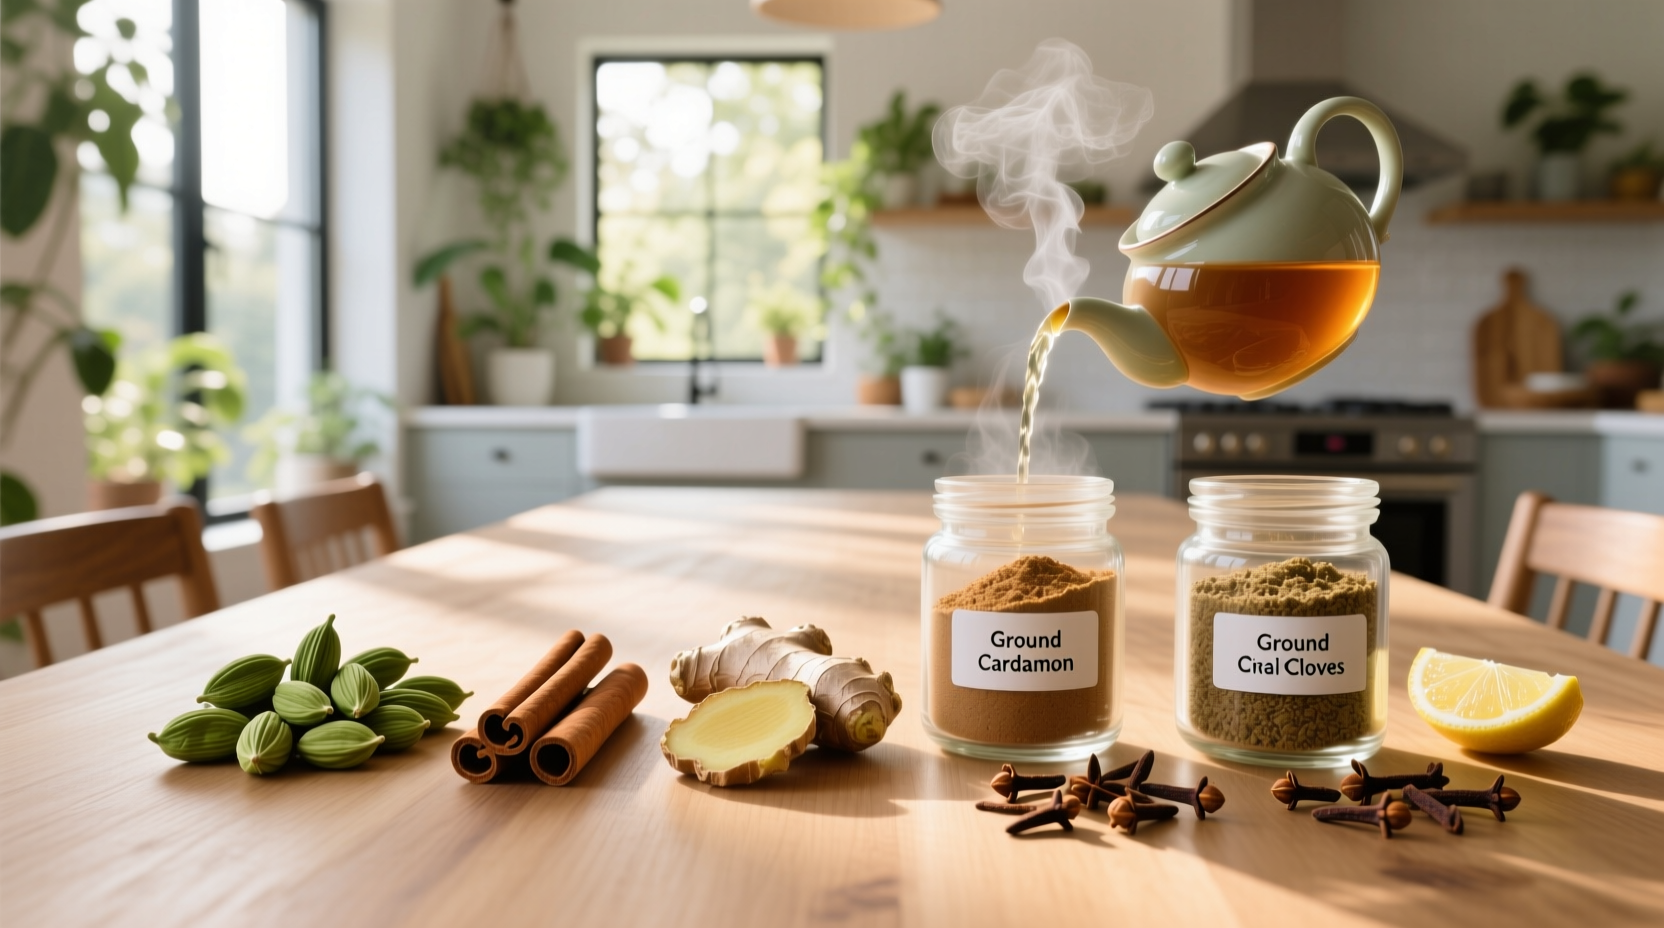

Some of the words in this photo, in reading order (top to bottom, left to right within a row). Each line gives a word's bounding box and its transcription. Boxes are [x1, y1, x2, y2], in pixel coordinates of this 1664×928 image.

[990, 628, 1062, 649] Ground
[1256, 632, 1330, 652] Ground
[978, 653, 1074, 673] Cardamon
[1283, 657, 1346, 677] Cloves
